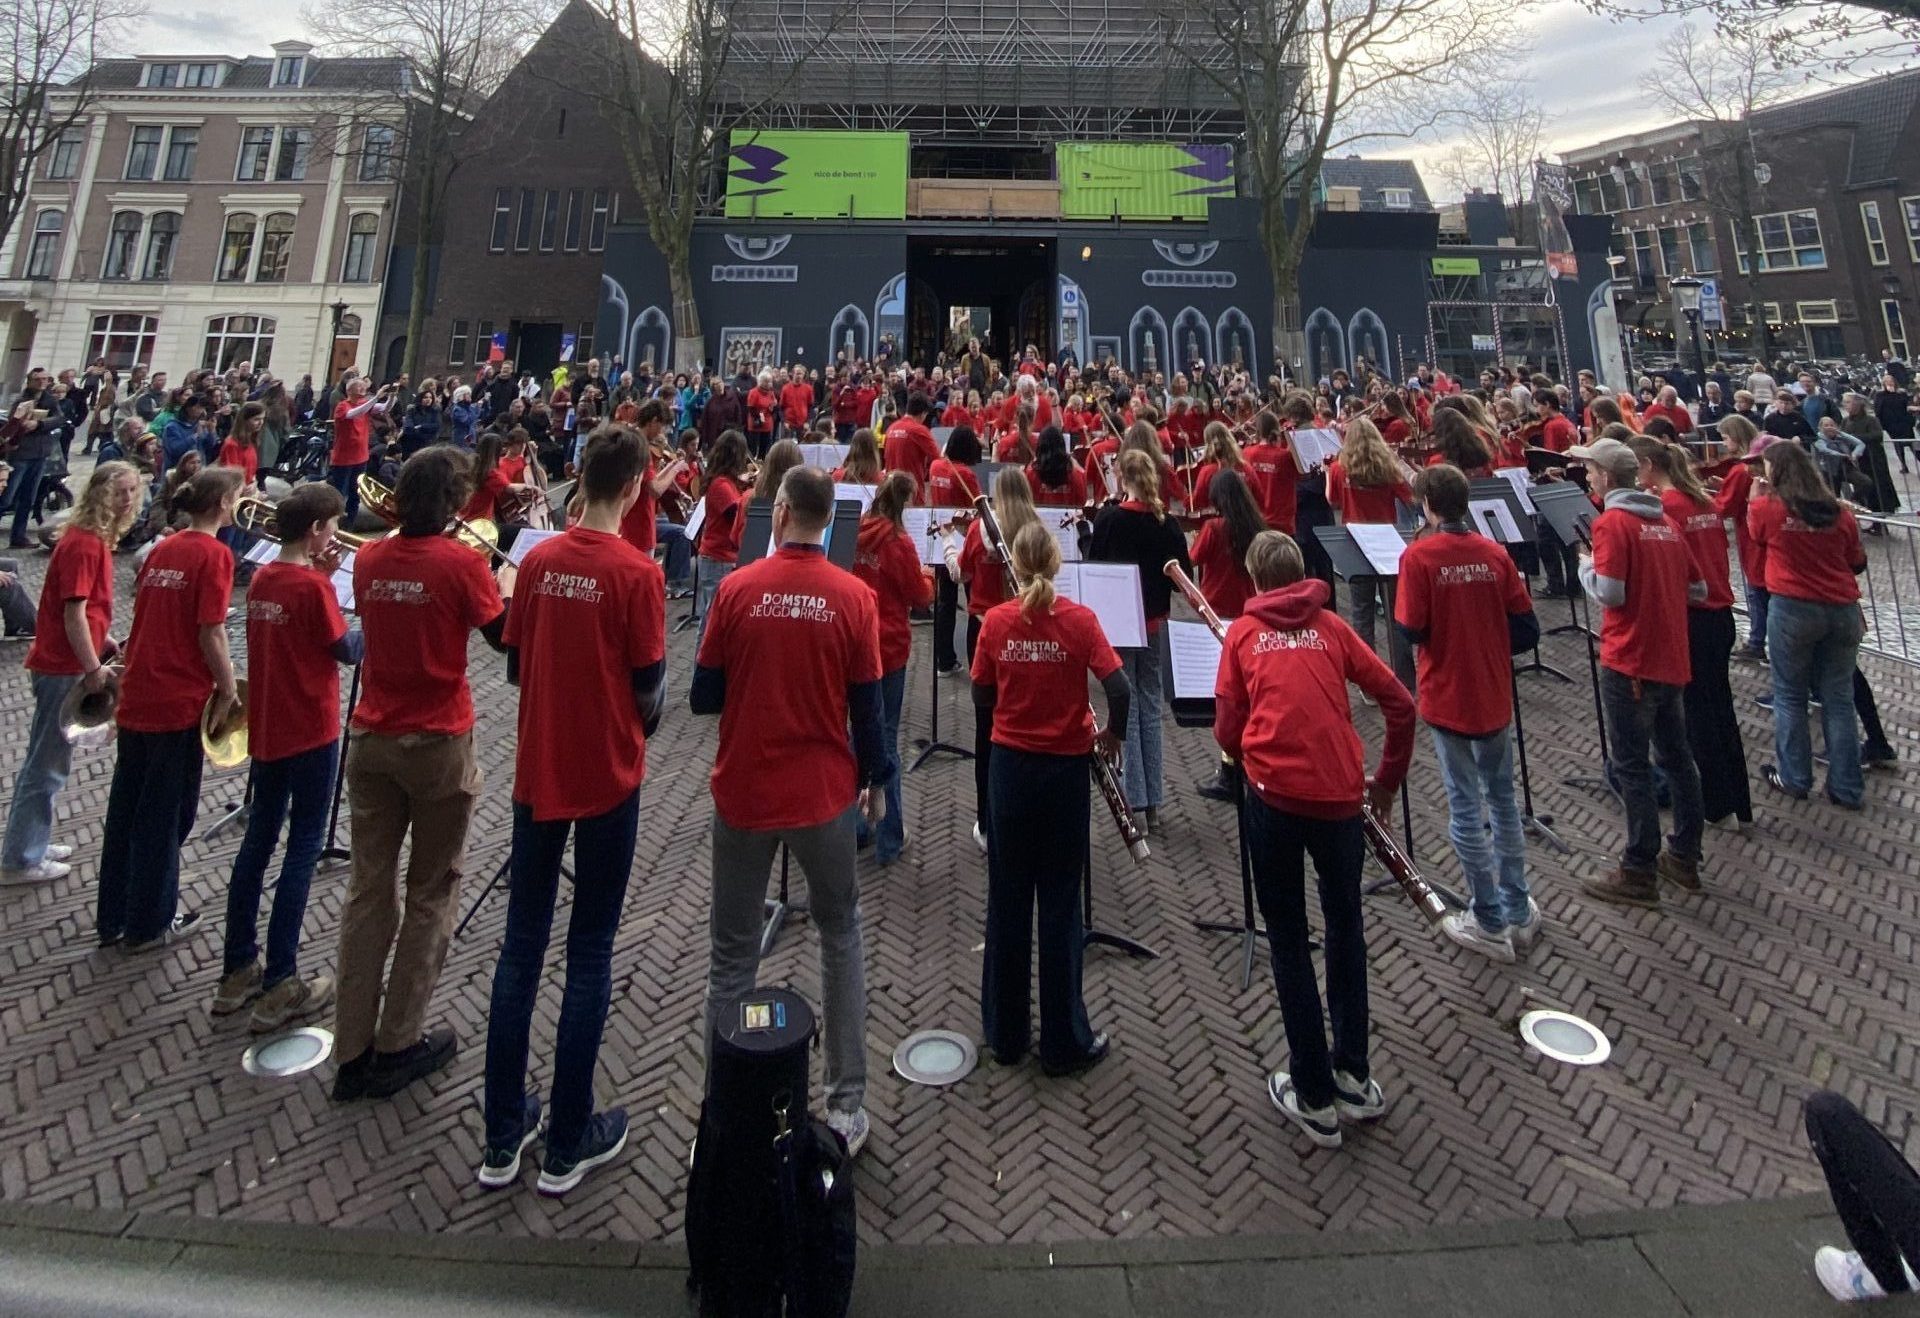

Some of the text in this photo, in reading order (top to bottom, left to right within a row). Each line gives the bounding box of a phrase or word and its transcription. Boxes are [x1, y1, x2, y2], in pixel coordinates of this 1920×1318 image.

[1440, 564, 1489, 575] DOMSTAD
[544, 571, 597, 590] DOMSTAD
[762, 593, 826, 609] DOMSTAD
[749, 604, 836, 623] JEUGDORKEST
[1259, 629, 1319, 642] DOMSTAD
[1007, 640, 1060, 652] DOMSTAD
[998, 650, 1067, 663] JEUGDORKEST
